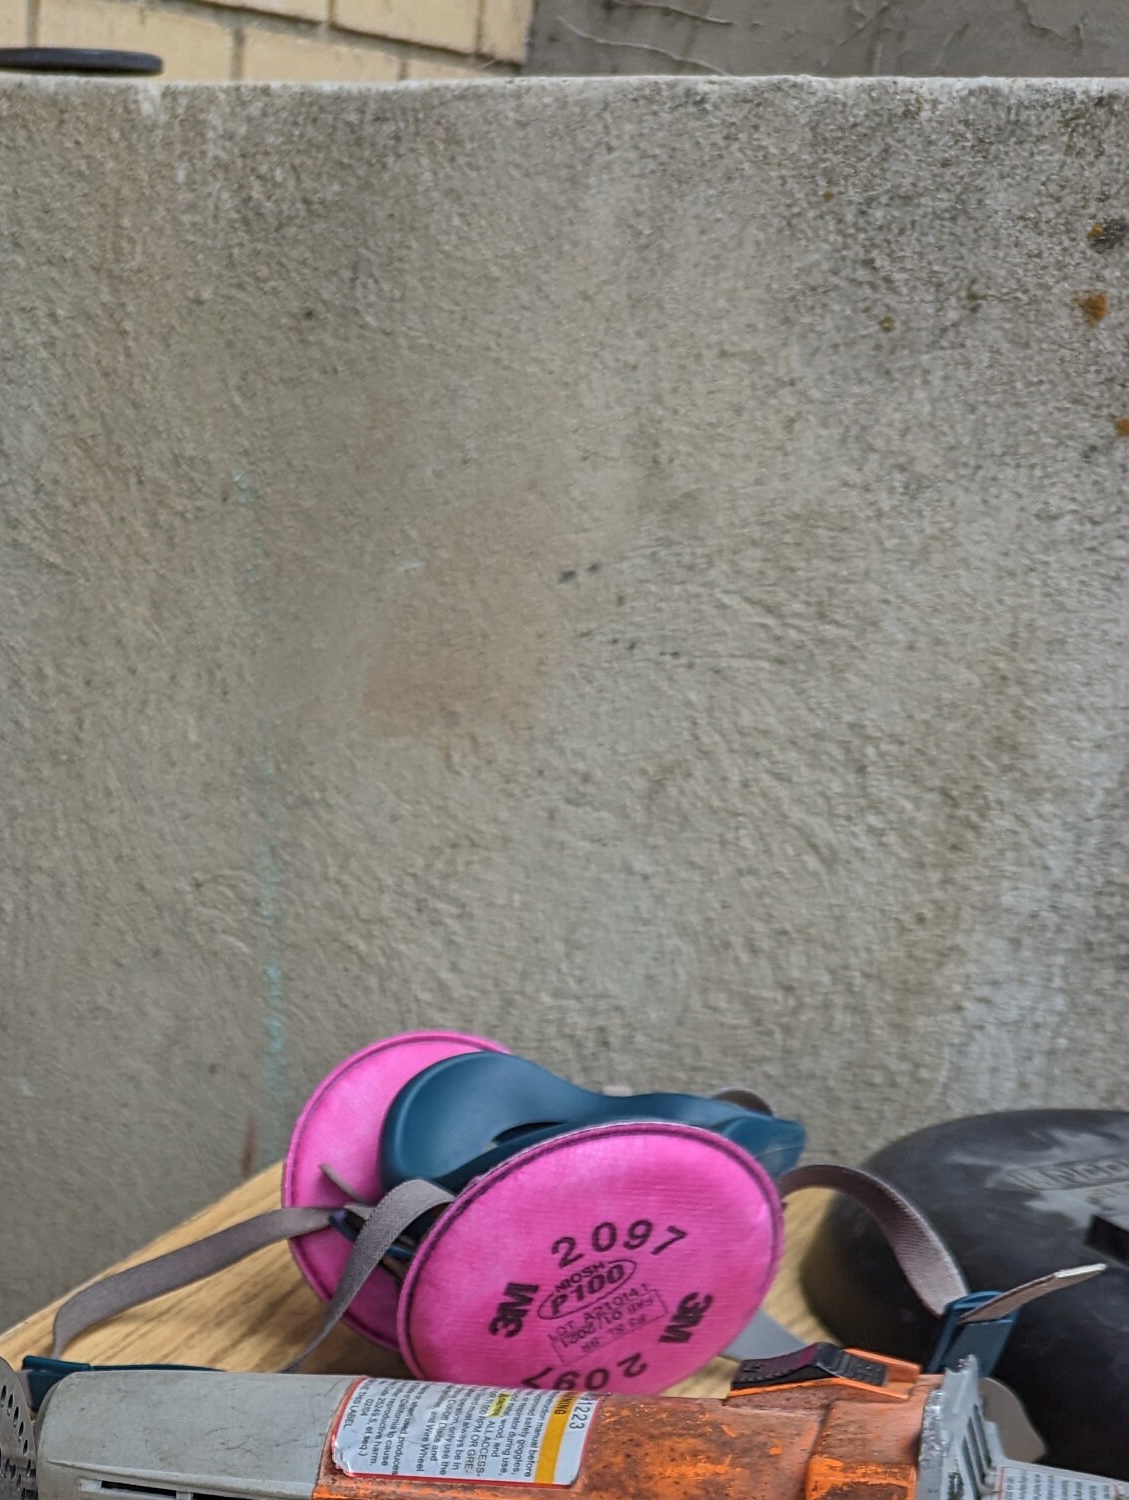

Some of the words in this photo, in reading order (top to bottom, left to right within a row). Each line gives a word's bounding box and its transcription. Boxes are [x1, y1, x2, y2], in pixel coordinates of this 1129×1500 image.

[551, 1219, 687, 1269] 2097
[555, 1261, 605, 1293] NIOSH
[551, 1264, 625, 1315] P100
[488, 1282, 539, 1338] 3M
[657, 1292, 714, 1343] 3M
[521, 1353, 648, 1390] 2097
[342, 1405, 358, 1430] LABEL.
[374, 1398, 395, 1439] reproductive
[389, 1398, 408, 1429] California
[427, 1410, 438, 1422] and
[472, 1416, 485, 1432] RPM
[510, 1402, 526, 1430] respirator
[386, 1430, 395, 1438] to
[398, 1418, 411, 1436] used,
[421, 1424, 435, 1442] Wire
[433, 1422, 447, 1442] Discs
[443, 1426, 455, 1442] only
[455, 1421, 470, 1447] always
[483, 1420, 496, 1434] ALL
[493, 1418, 507, 1440] wood,
[517, 1417, 532, 1438] safety
[529, 1422, 544, 1447] manual
[357, 1435, 370, 1456] seq.)
[441, 1444, 451, 1458] use
[468, 1434, 480, 1446] OR
[490, 1442, 500, 1456] and
[501, 1432, 517, 1455] during
[369, 1441, 382, 1465] harm.
[380, 1440, 392, 1466] cause
[391, 1436, 405, 1474] produces
[415, 1443, 430, 1471] Wheel
[429, 1444, 440, 1461] and
[453, 1450, 464, 1460] be
[463, 1449, 476, 1472] GRE-
[474, 1436, 491, 1476] ACCESS-
[511, 1439, 526, 1474] goggles,
[524, 1450, 537, 1476] before
[438, 1461, 449, 1474] the
[451, 1462, 461, 1470] in
[498, 1457, 509, 1475] use,
